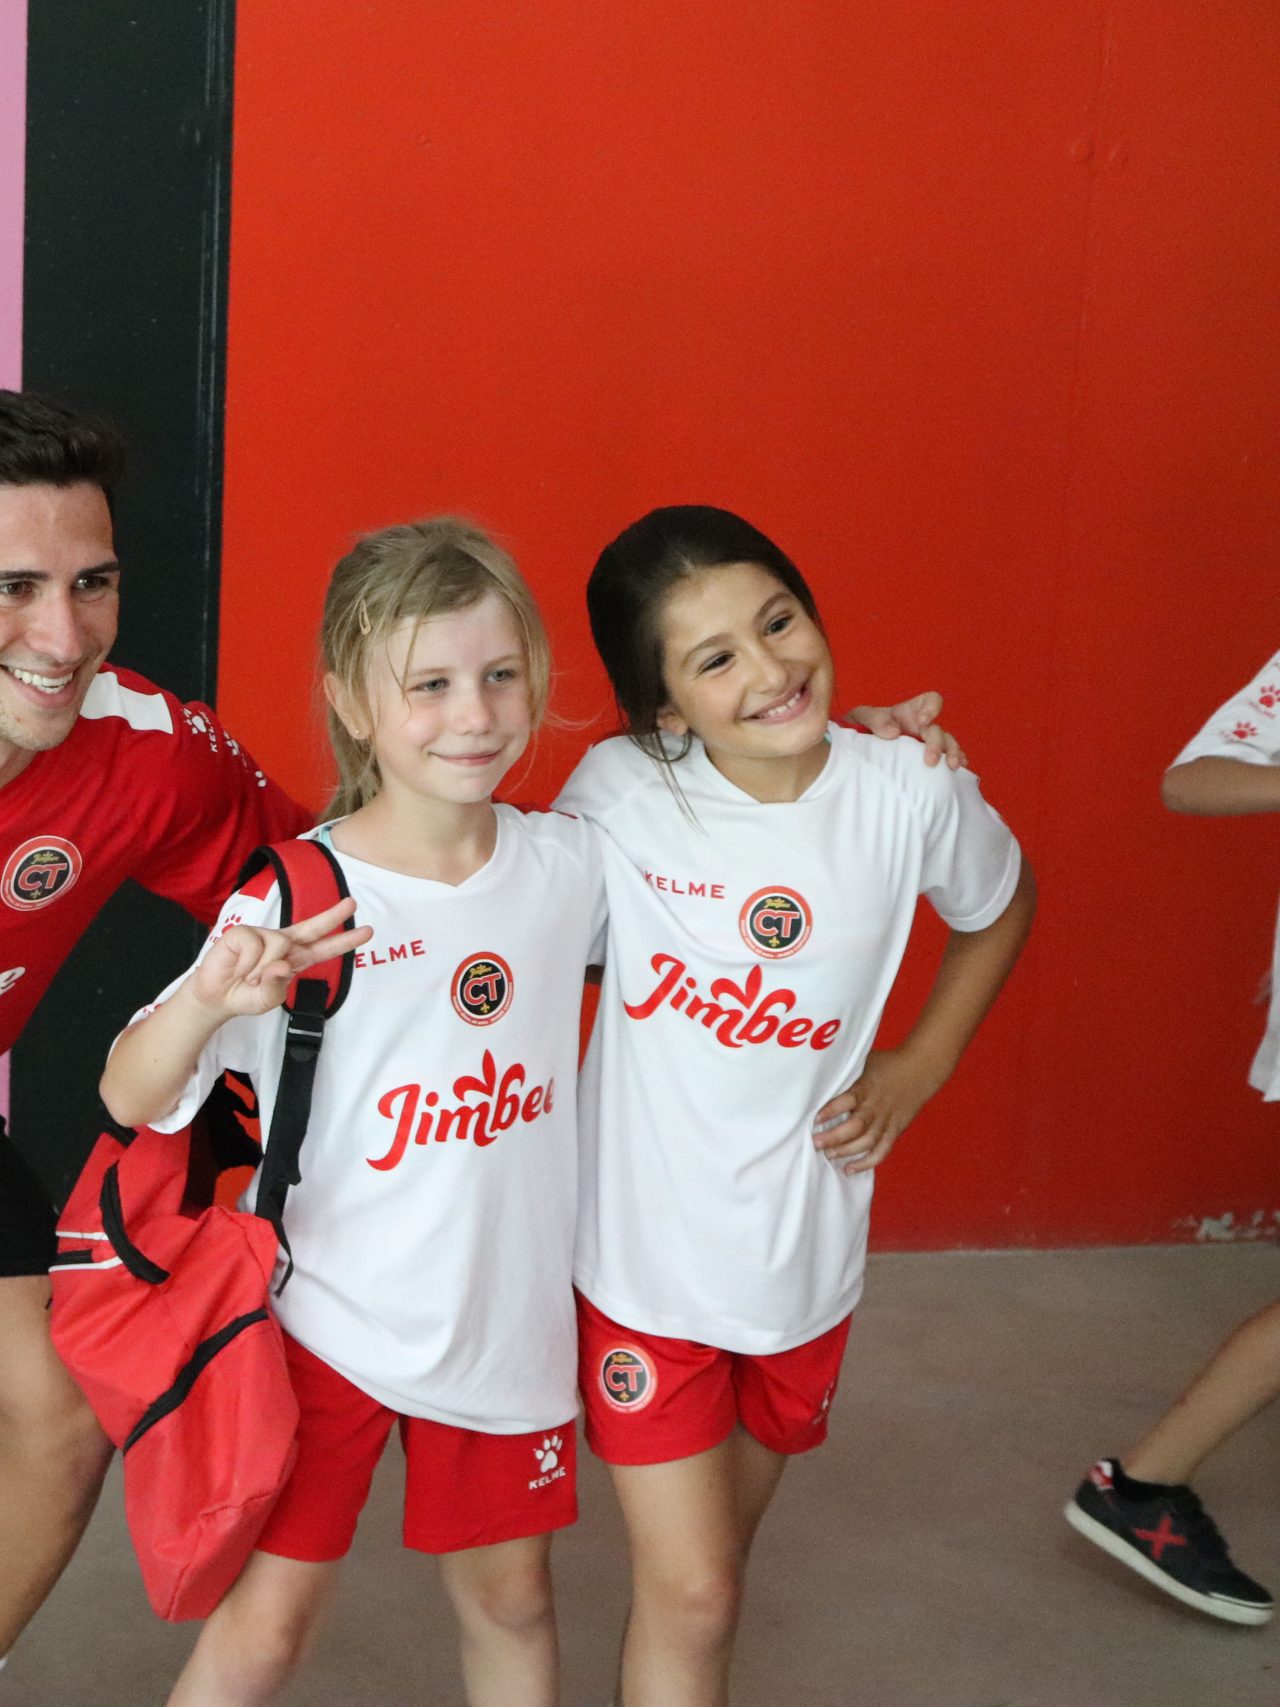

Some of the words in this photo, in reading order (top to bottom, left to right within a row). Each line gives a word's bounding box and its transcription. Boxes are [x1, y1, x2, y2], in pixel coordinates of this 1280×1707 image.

[18, 862, 68, 891] CT
[753, 909, 801, 938] CT
[355, 939, 427, 969] ELME
[463, 971, 502, 1006] CT
[623, 952, 842, 1051] Jimbee
[605, 1364, 644, 1392] CT
[528, 1466, 567, 1491] KELME
